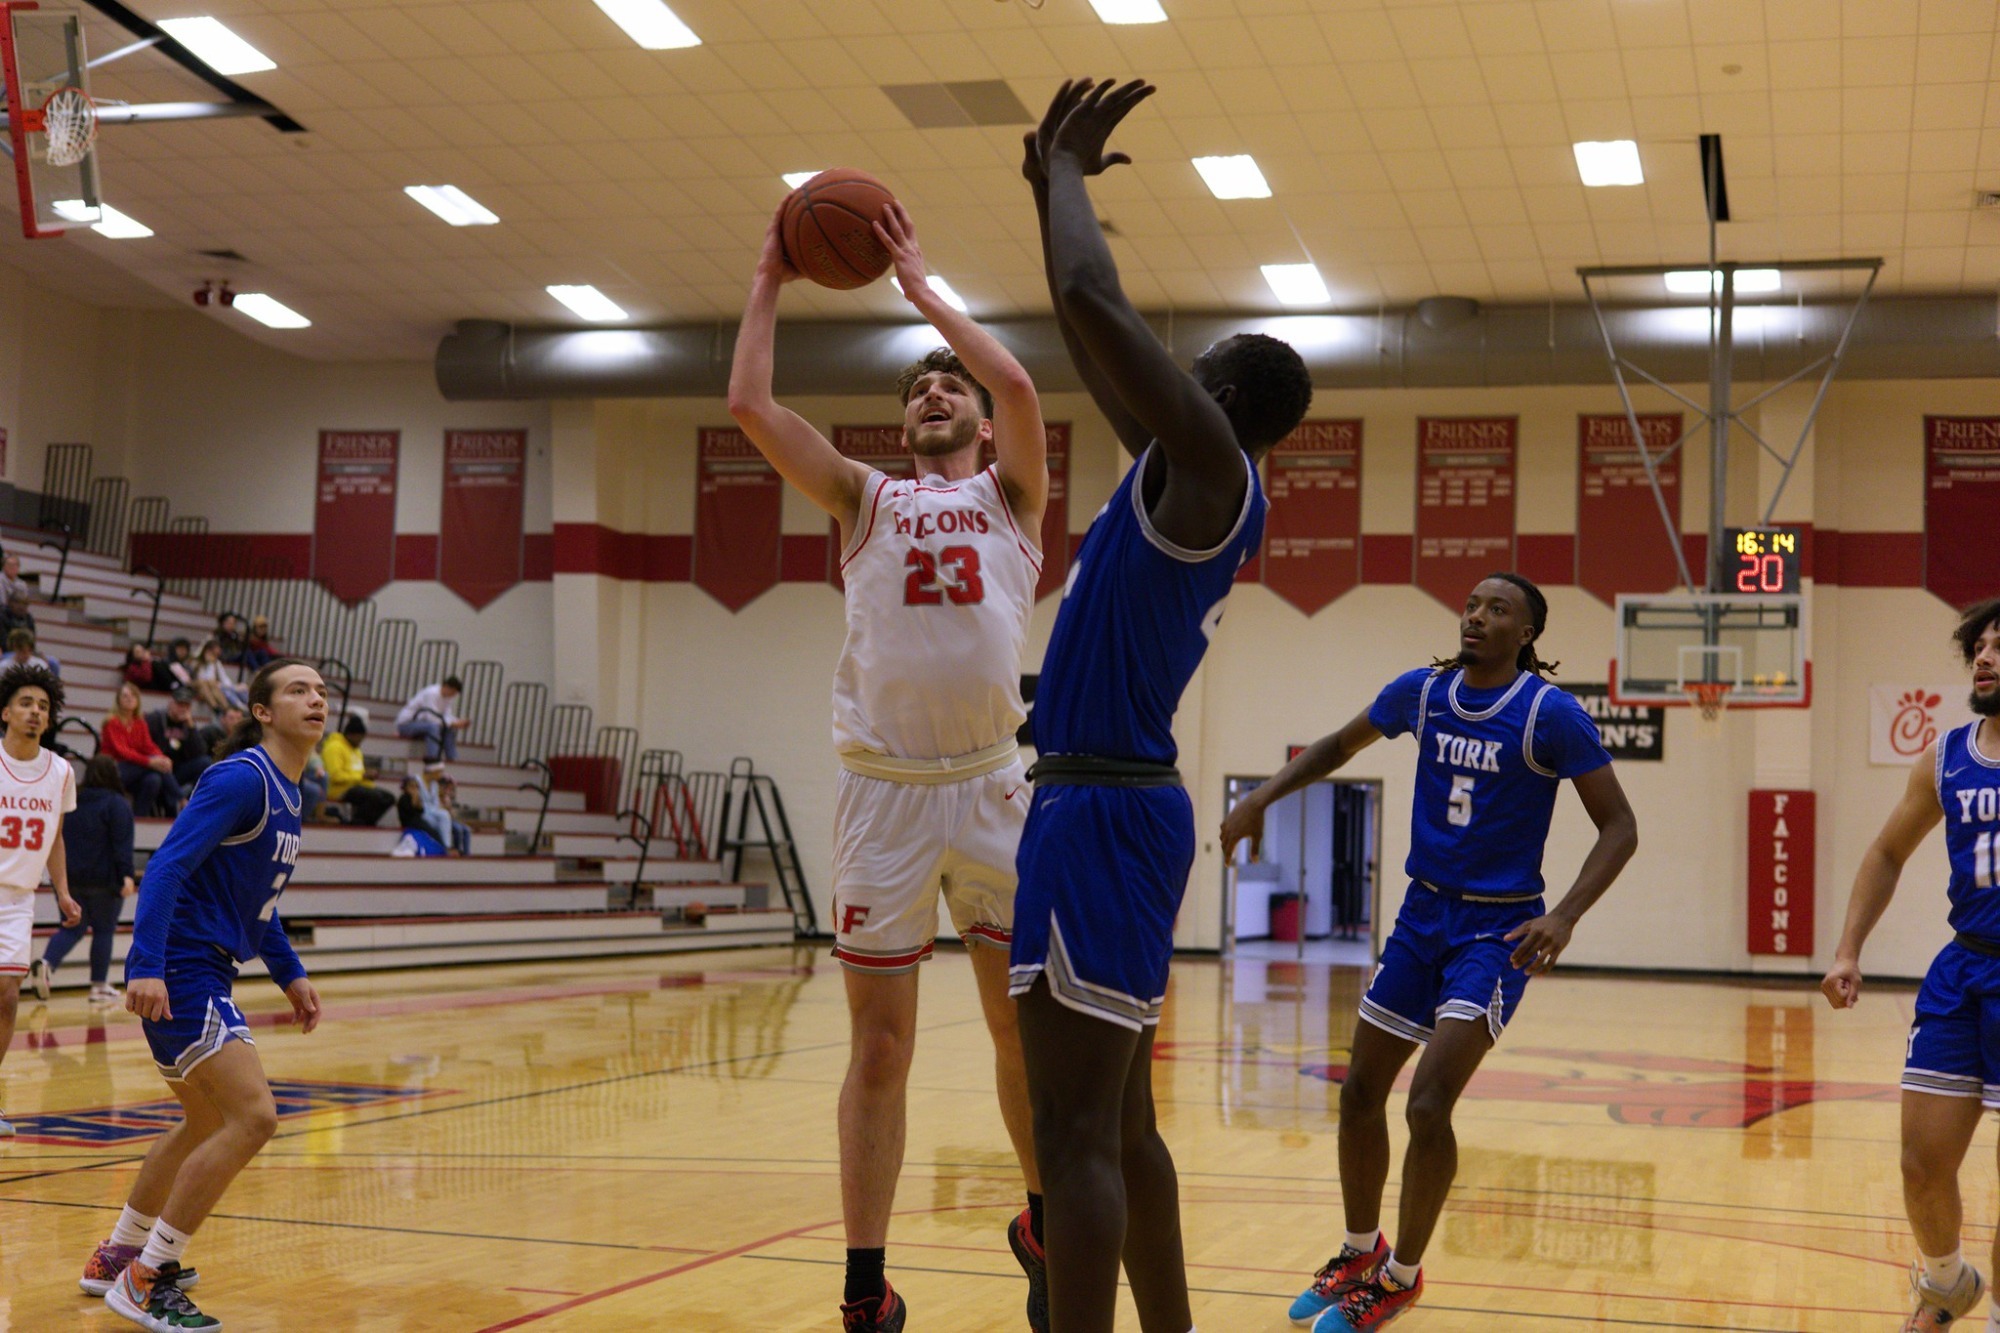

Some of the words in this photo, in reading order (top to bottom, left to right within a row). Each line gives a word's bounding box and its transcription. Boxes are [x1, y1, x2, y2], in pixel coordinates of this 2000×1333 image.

[841, 430, 903, 446] FRIEN
[1427, 421, 1508, 439] FRIENDS
[1935, 419, 2000, 437] FRIEN
[1736, 531, 1795, 555] 16:14
[903, 545, 985, 607] 23
[1737, 554, 1784, 592] 20
[1435, 732, 1503, 773] YORK
[0, 796, 53, 813] ALCONS
[1447, 774, 1476, 827] 5
[1956, 787, 2000, 823] YO
[0, 815, 45, 852] 33
[272, 830, 302, 863] YOR
[1771, 794, 1790, 953] FALCONS
[841, 904, 871, 935] F
